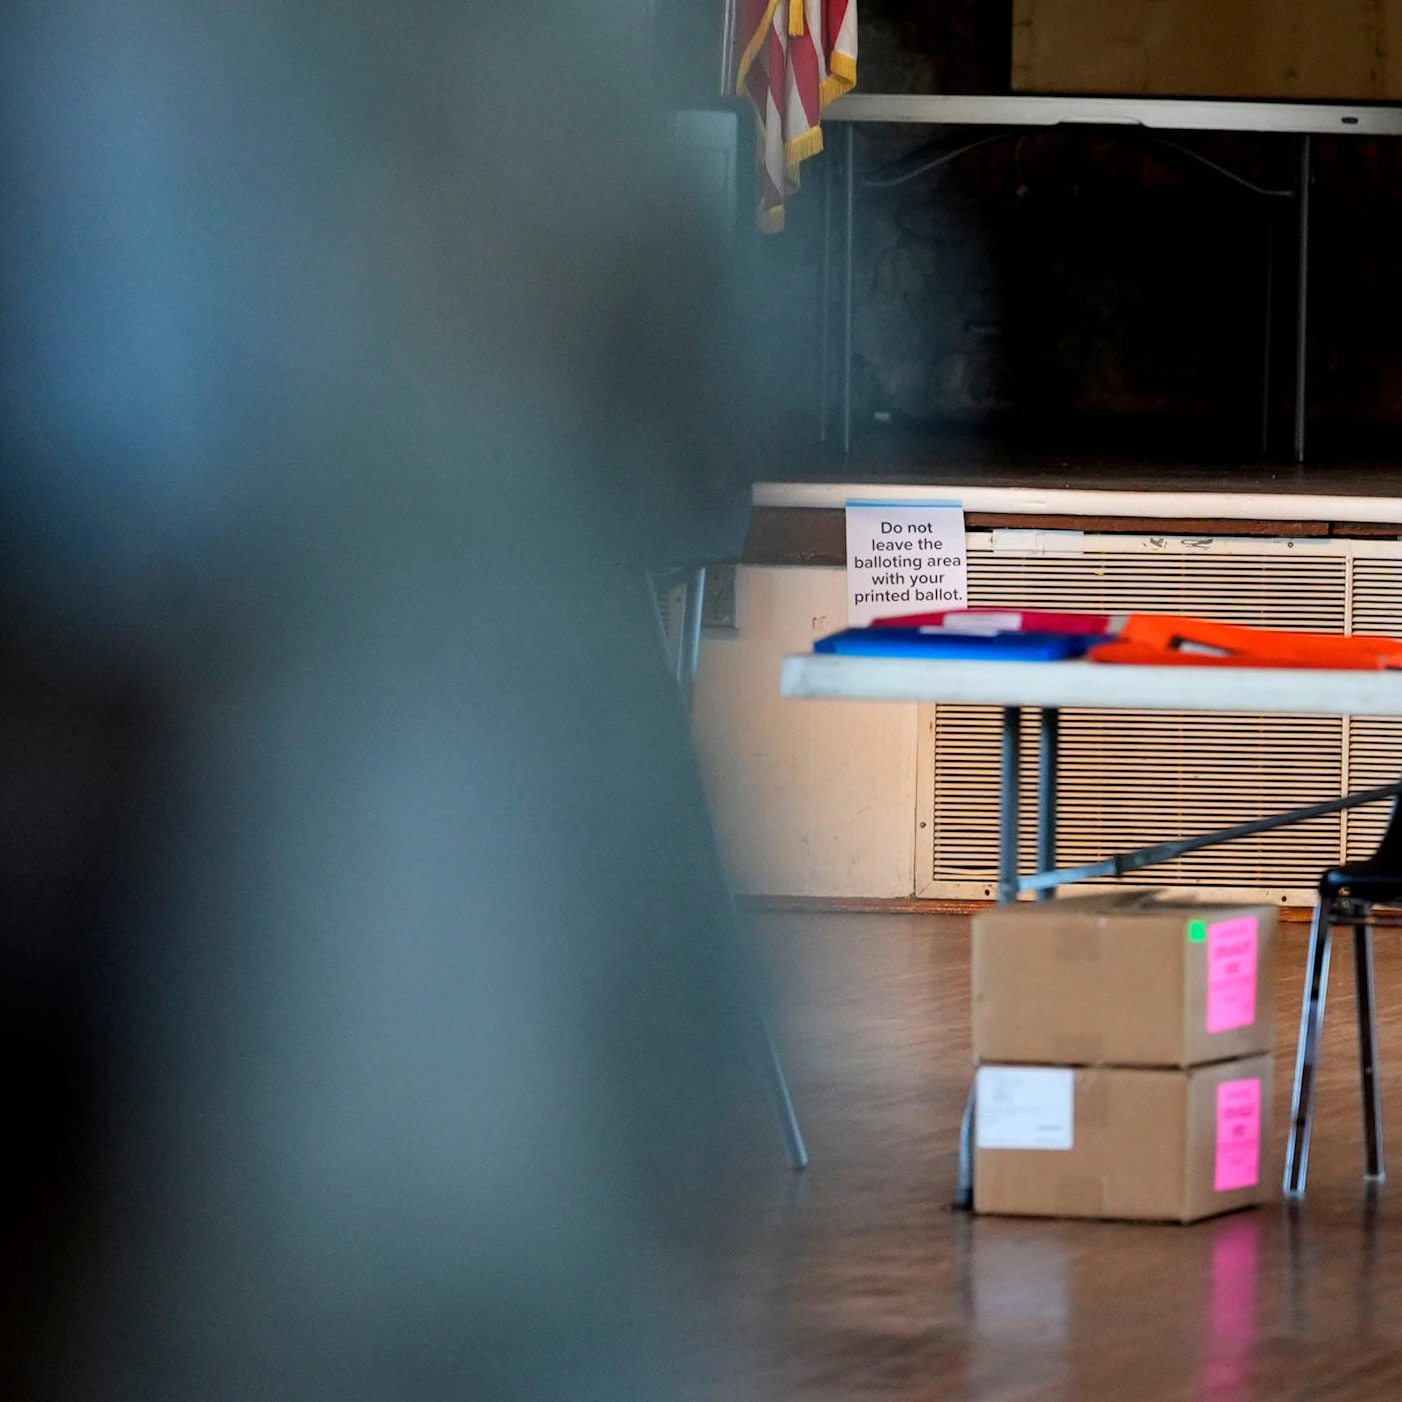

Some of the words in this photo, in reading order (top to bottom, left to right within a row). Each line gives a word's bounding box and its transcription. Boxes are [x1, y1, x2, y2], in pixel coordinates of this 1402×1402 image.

[881, 521, 902, 534] Do
[908, 522, 933, 534] not
[872, 539, 913, 551] leave
[918, 538, 943, 550] the
[854, 555, 922, 570] balloting
[927, 557, 961, 567] area
[871, 573, 905, 585] with
[910, 574, 945, 587] your
[854, 589, 910, 605] printed
[915, 589, 963, 601] ballot.
